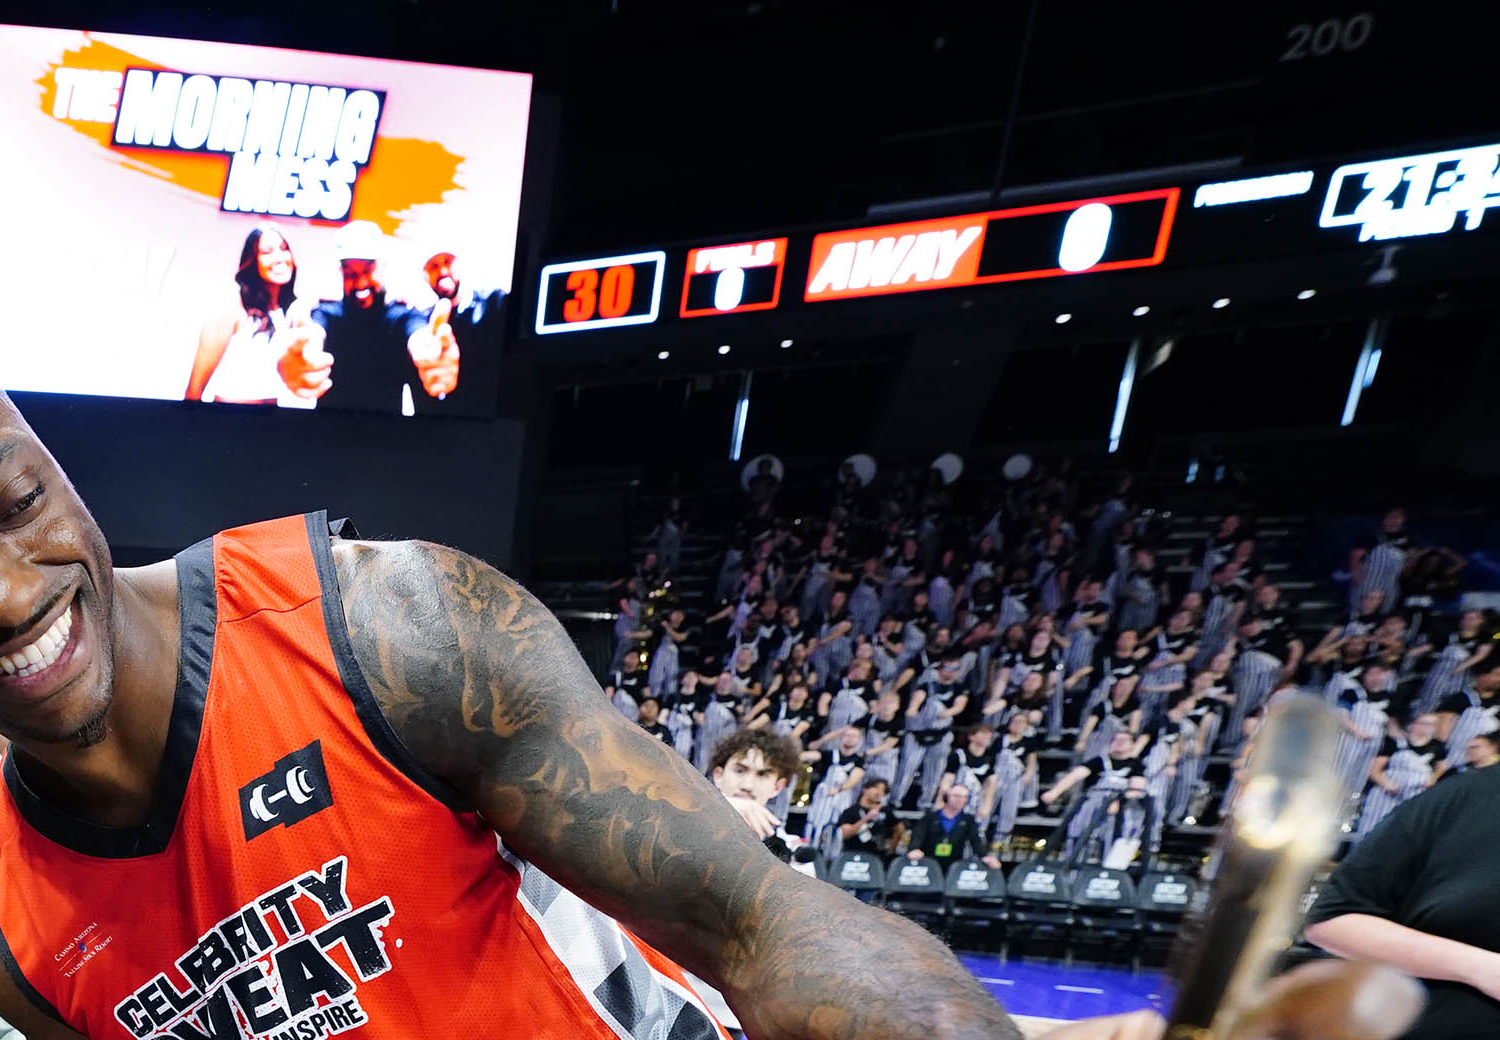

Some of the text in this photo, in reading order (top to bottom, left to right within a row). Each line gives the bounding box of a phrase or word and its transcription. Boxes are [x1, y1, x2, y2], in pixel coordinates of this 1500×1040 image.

[1278, 13, 1373, 62] 200
[53, 67, 380, 164] THE MORNING
[222, 151, 357, 220] MESS
[808, 203, 1113, 294] AWAY 0
[563, 264, 635, 323] 30
[714, 267, 745, 311] 0
